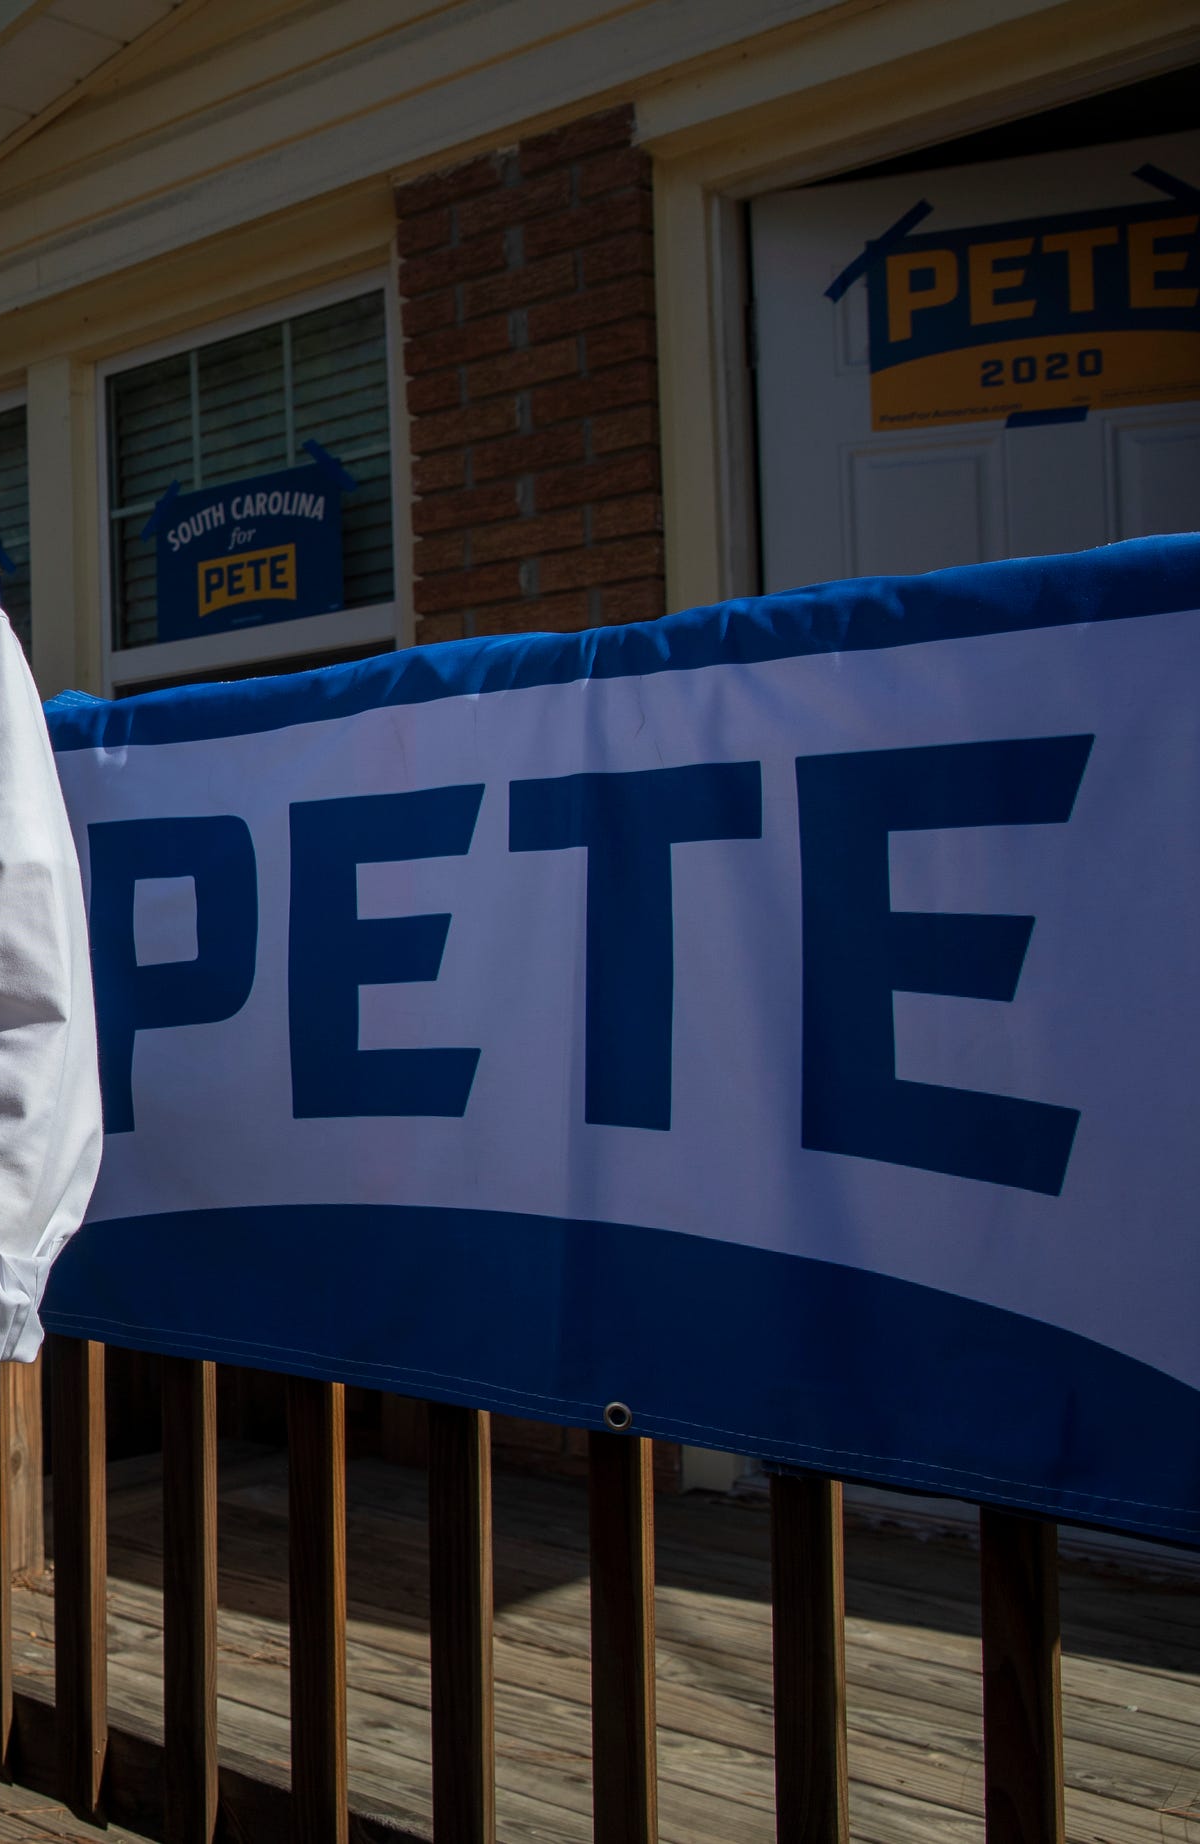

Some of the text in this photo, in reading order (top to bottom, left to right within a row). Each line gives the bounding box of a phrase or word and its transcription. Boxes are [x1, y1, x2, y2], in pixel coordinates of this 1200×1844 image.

[886, 215, 1200, 343] PETE
[980, 349, 1103, 388] 2020
[166, 491, 325, 552] SOUTH CAROLINA
[228, 526, 256, 550] for
[204, 553, 289, 604] PETE
[87, 733, 1094, 1197] PETE
